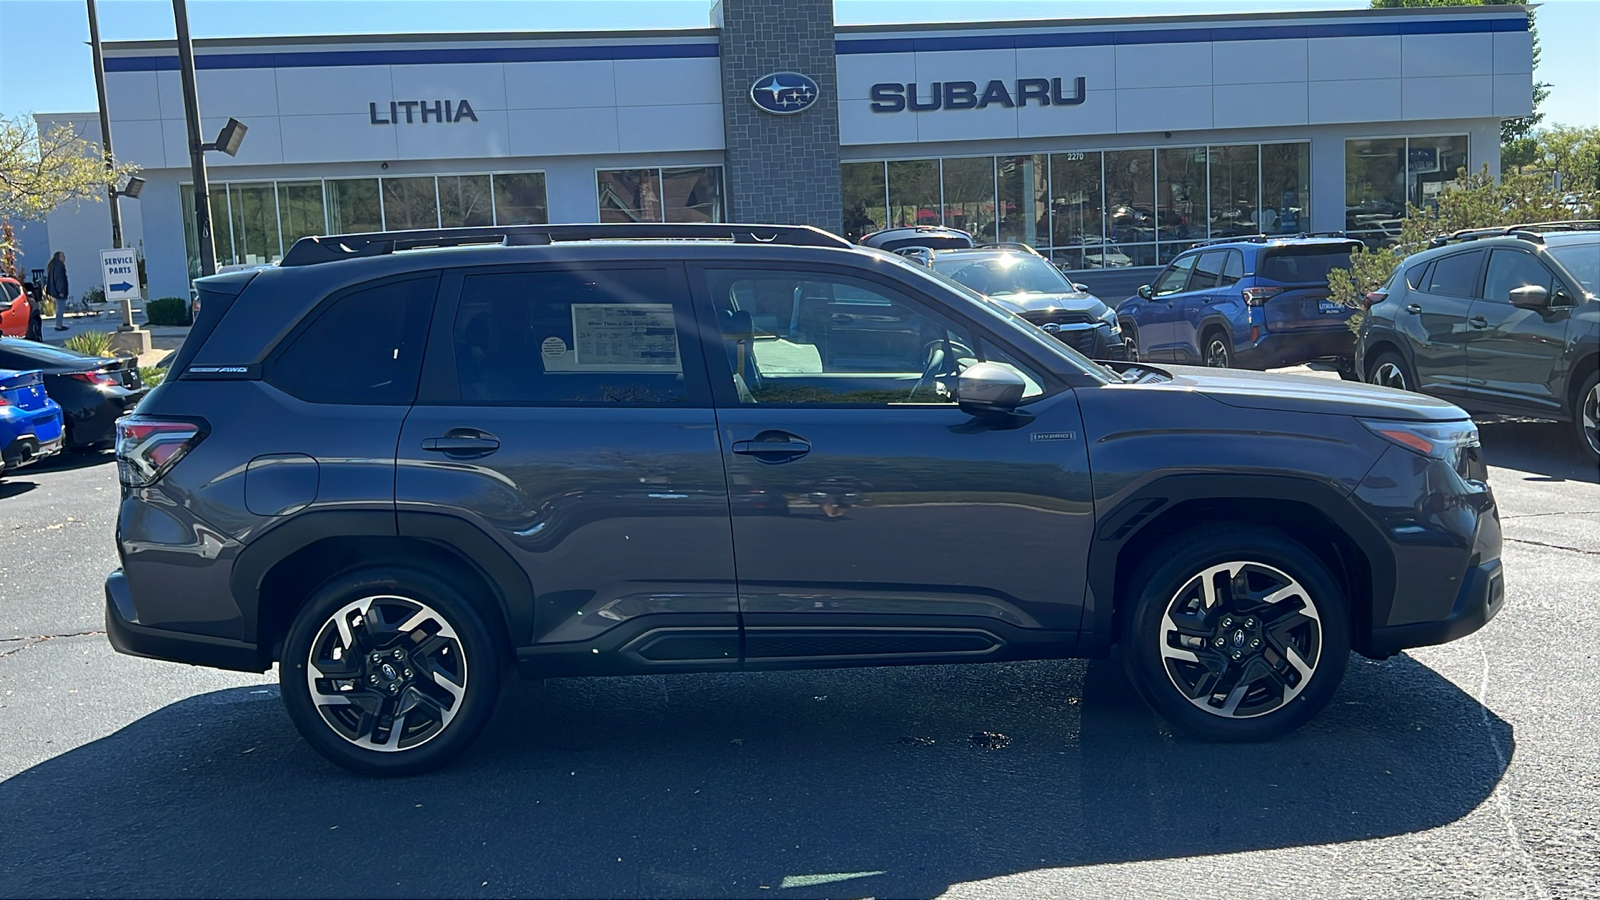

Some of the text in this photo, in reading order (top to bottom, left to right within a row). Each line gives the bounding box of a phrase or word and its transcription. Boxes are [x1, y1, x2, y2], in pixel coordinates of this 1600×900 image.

[870, 76, 1086, 113] SUBARU
[369, 99, 479, 124] LITHIA
[1067, 152, 1084, 160] 2270
[104, 256, 133, 266] SERVICE
[109, 266, 132, 275] PARTS
